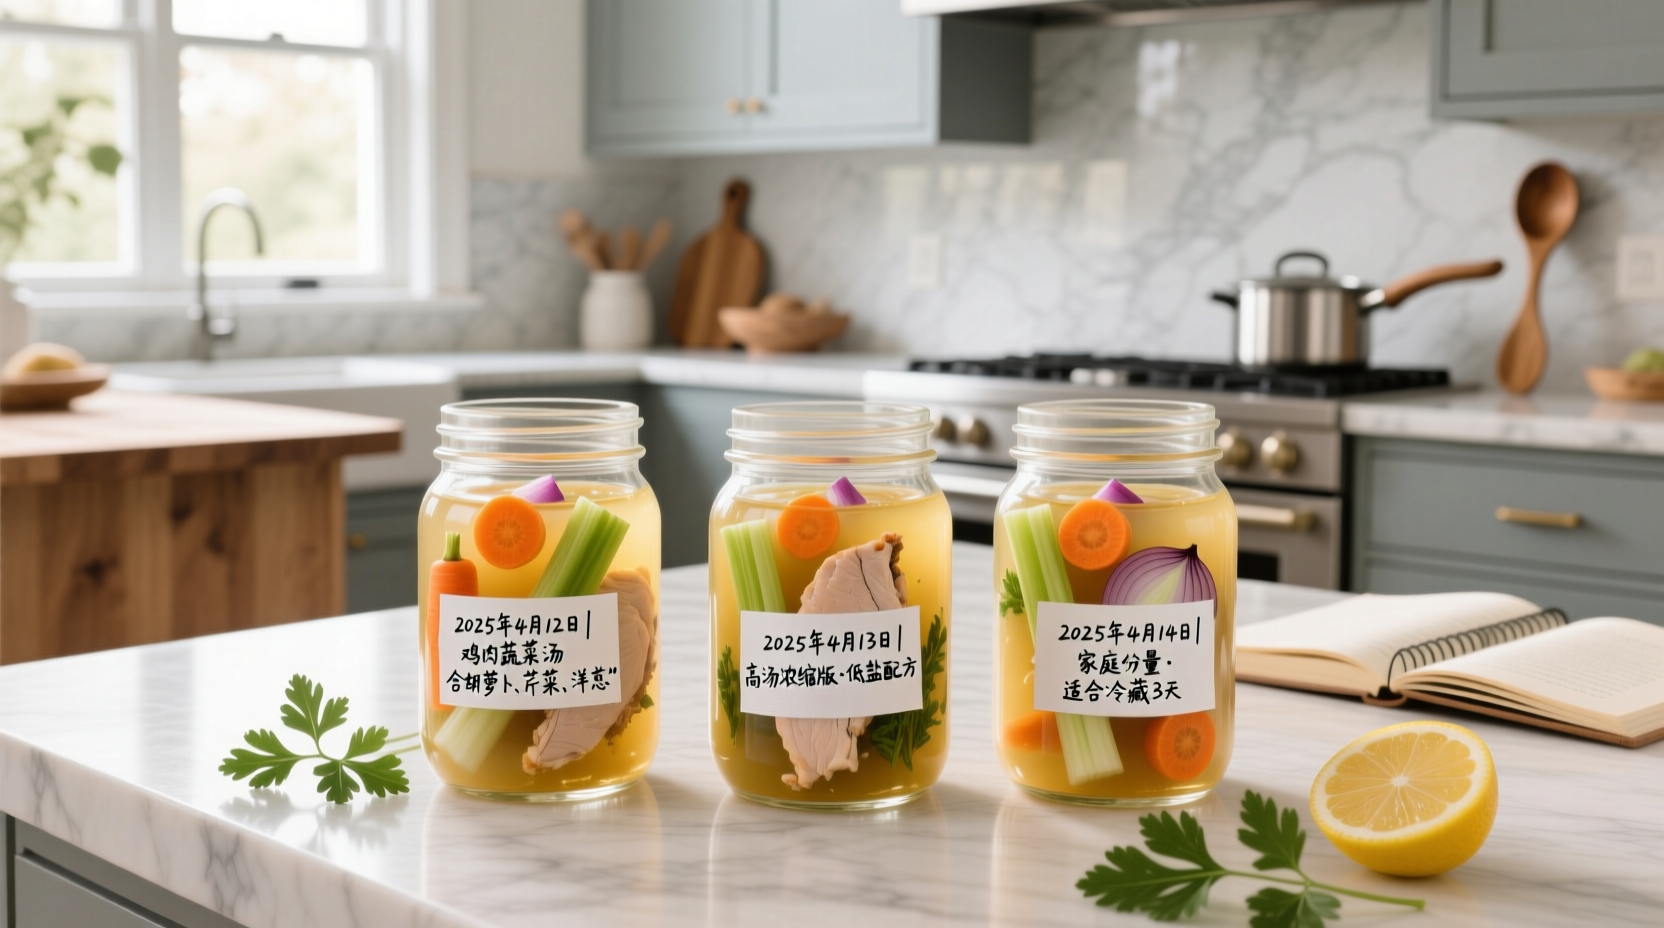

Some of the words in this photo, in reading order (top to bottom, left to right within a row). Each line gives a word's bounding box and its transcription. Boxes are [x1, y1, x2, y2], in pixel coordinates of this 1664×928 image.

[461, 639, 564, 666] 鸡肉蔬菜汤
[1062, 678, 1182, 704] 适合冷藏3天
